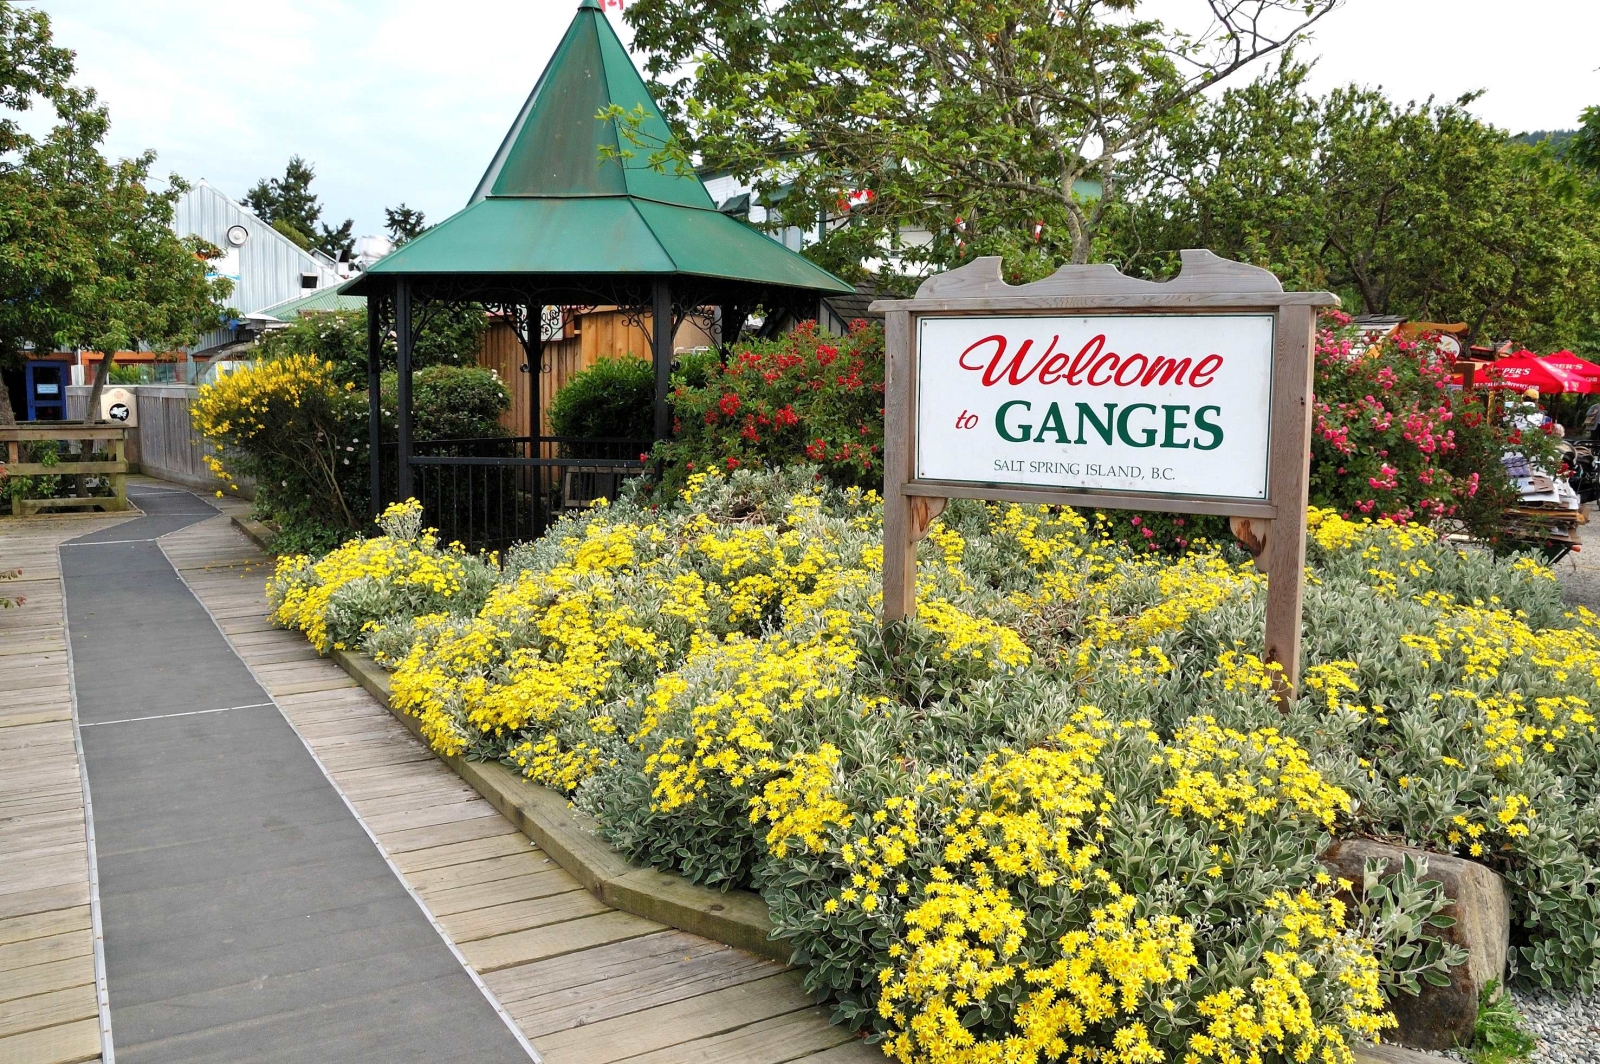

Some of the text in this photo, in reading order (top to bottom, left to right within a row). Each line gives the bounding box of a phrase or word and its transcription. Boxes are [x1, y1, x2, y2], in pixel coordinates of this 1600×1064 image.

[958, 334, 1224, 388] Welcome
[1502, 367, 1532, 376] PER'S
[955, 399, 1225, 451] to GANGES
[993, 459, 1176, 481] SALT SPRING ISLAND, B.C.
